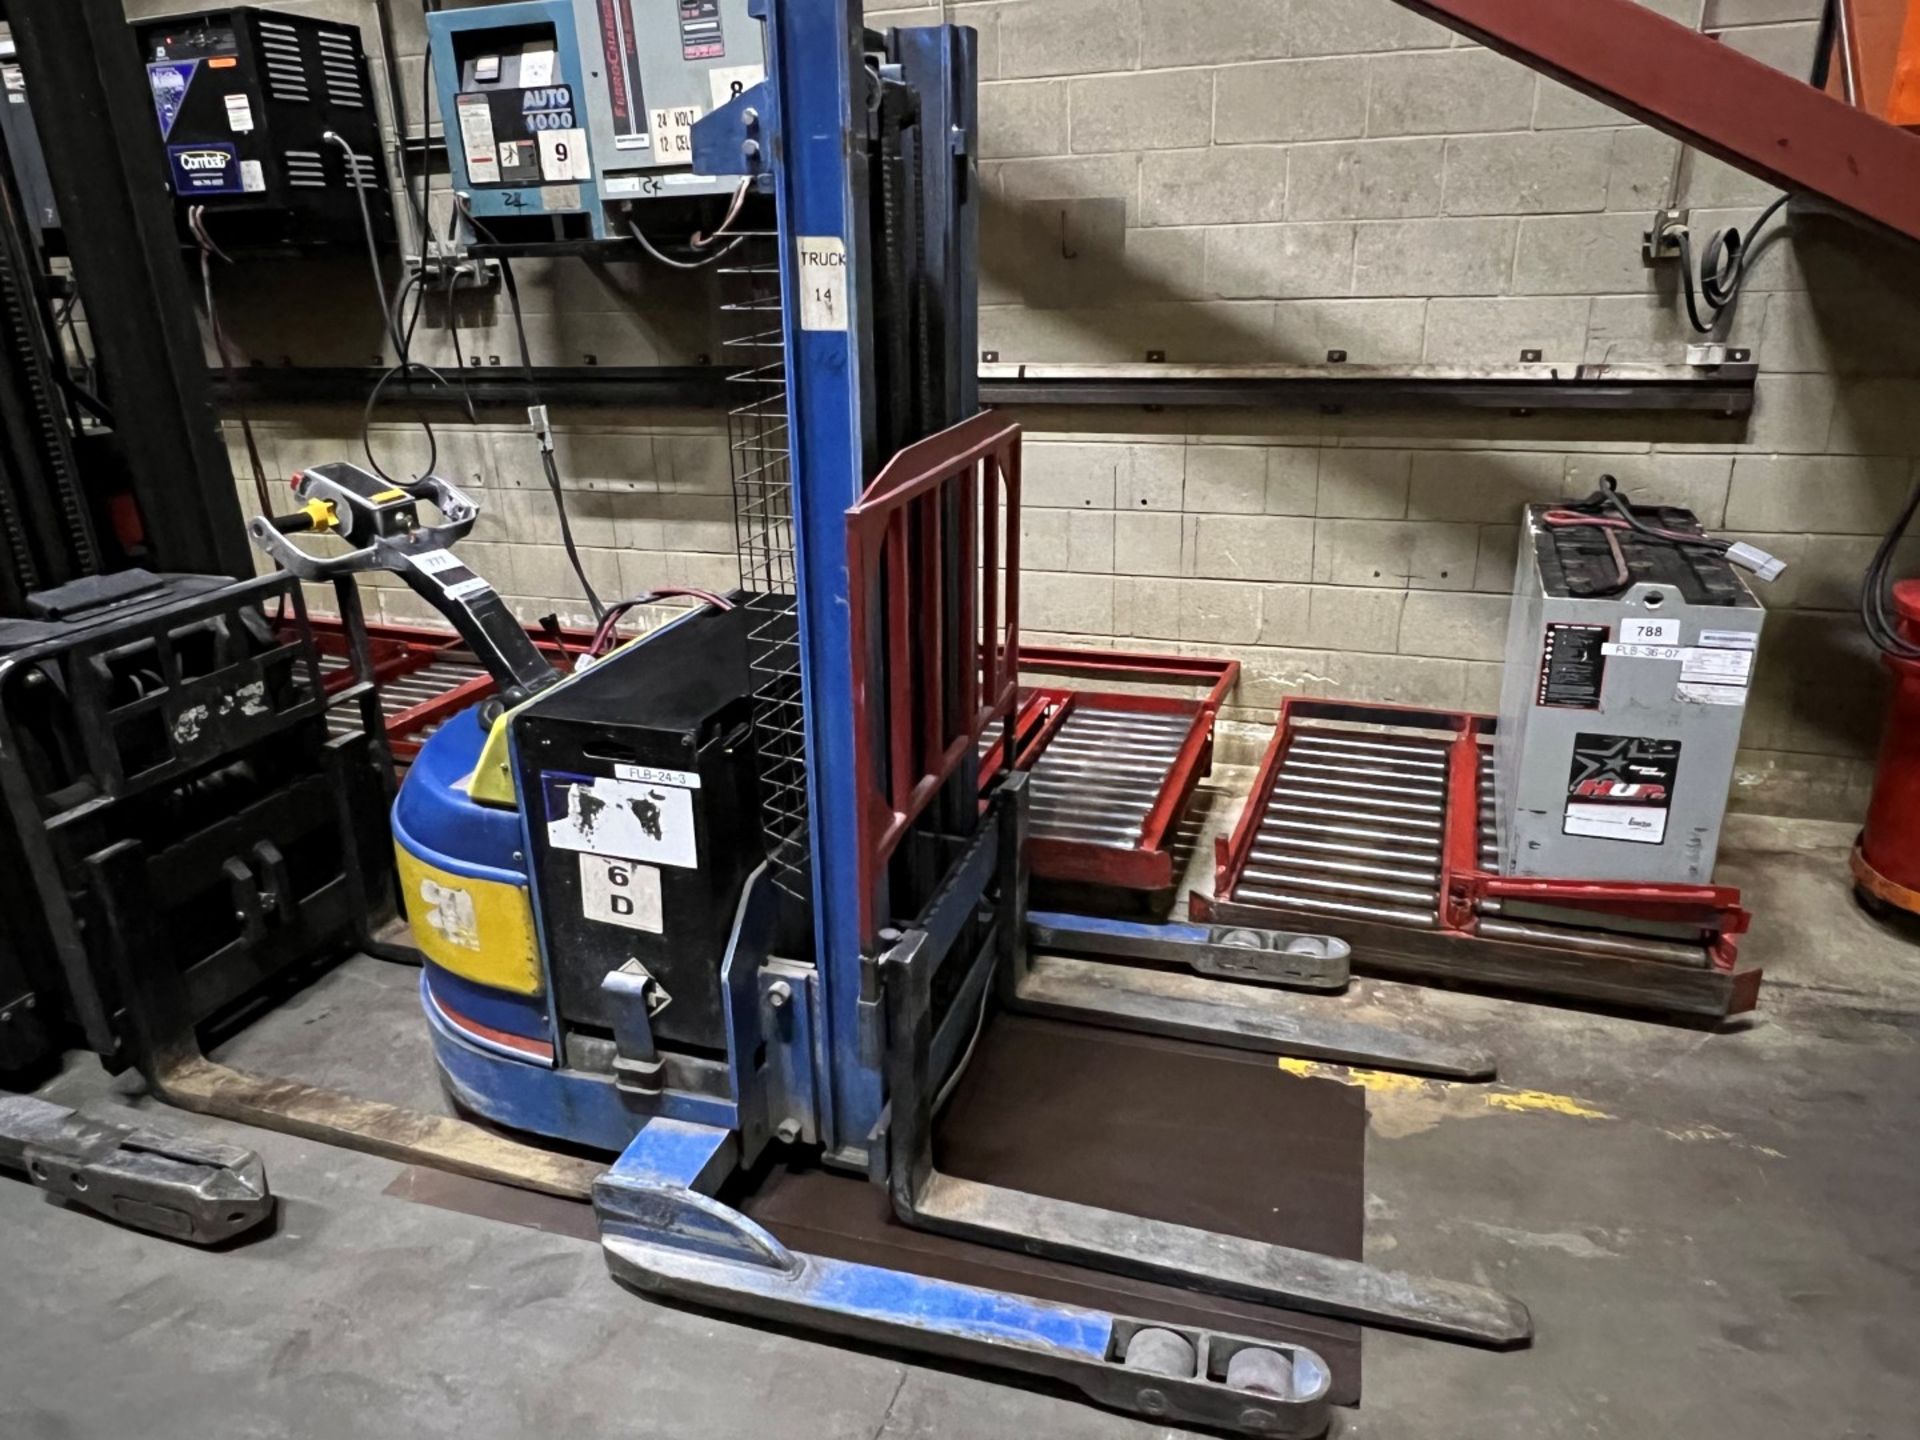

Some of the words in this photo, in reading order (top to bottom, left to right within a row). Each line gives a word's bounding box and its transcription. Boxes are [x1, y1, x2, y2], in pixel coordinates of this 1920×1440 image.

[522, 88, 570, 109] AUTO
[526, 113, 573, 134] 1000
[675, 135, 691, 151] CEL
[555, 143, 568, 162] 9
[801, 251, 846, 266] TRUCK
[815, 287, 832, 302] 14
[1637, 626, 1663, 638] 788
[629, 767, 687, 785] FLB-24-3
[607, 865, 630, 888] 6
[610, 894, 634, 916] D
